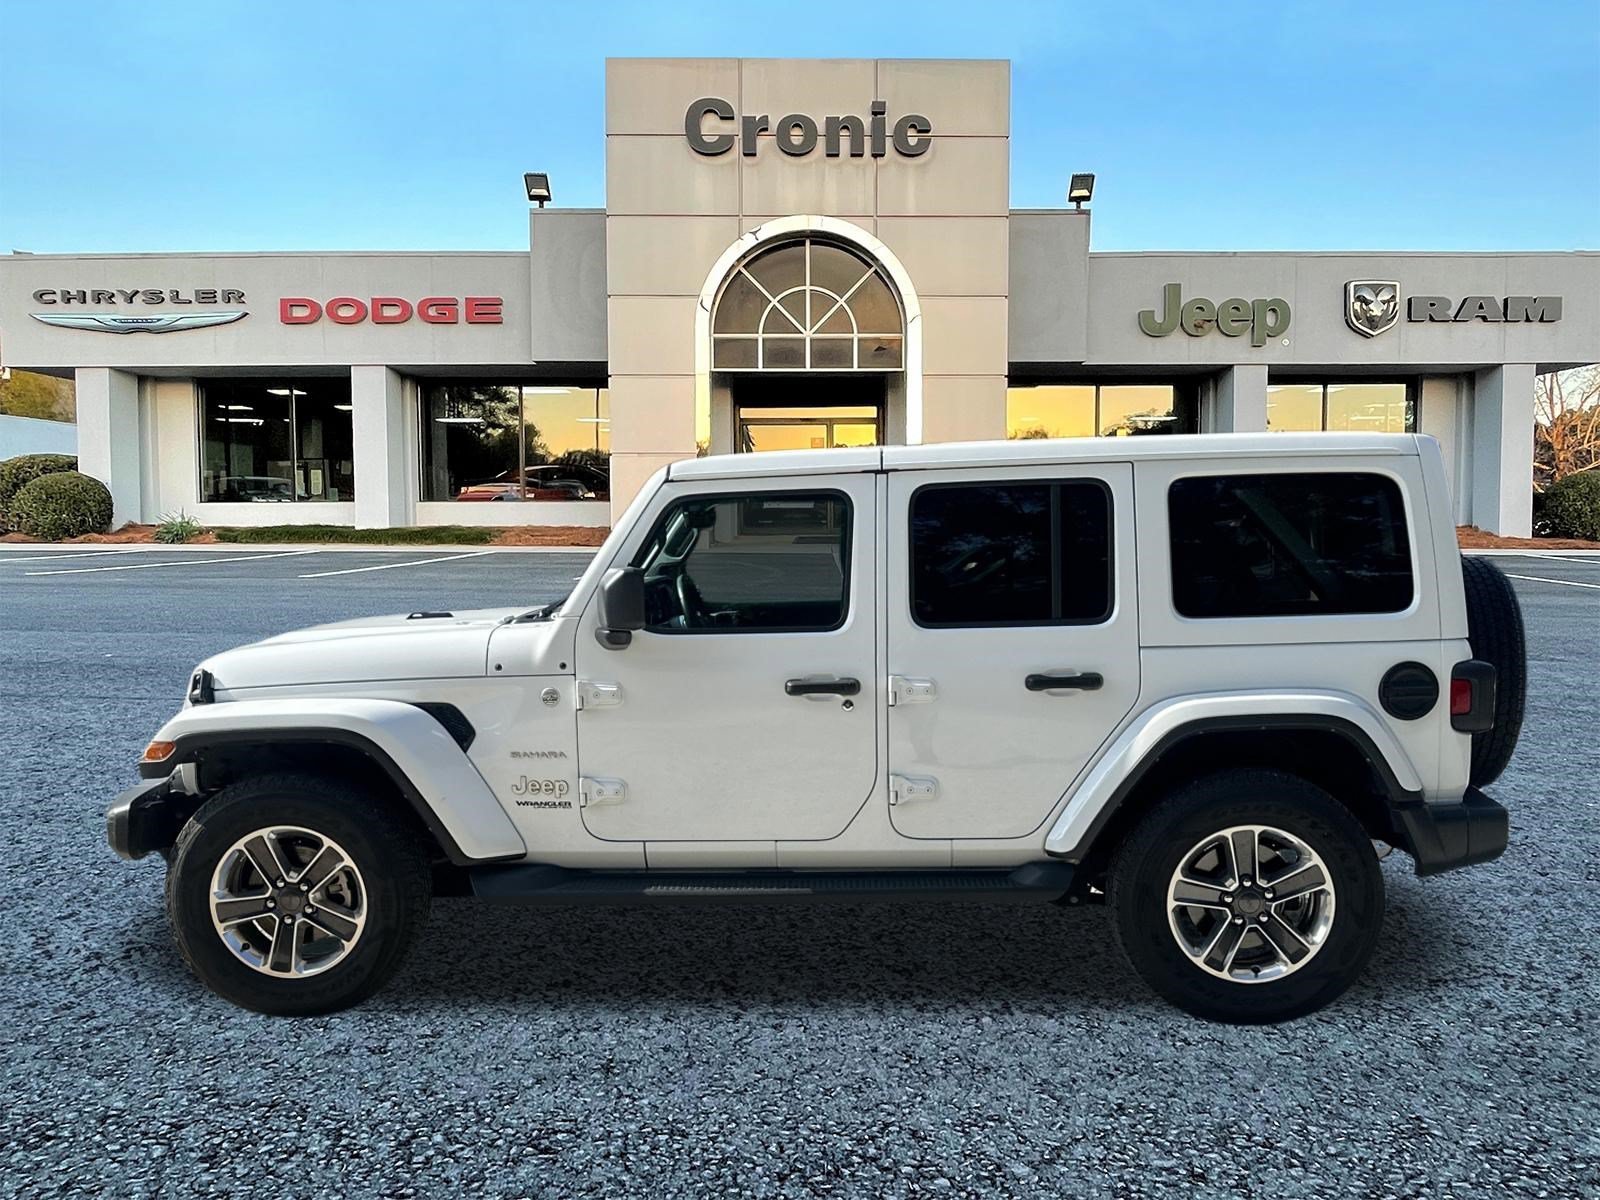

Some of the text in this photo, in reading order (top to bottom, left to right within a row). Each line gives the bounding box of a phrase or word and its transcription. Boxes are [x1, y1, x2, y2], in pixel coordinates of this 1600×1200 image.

[685, 97, 931, 157] Cronic
[32, 289, 247, 305] CHRYSLER
[1407, 296, 1563, 322] RAM
[280, 297, 503, 324] DODGE
[1138, 283, 1291, 347] Jeep
[511, 775, 569, 799] Jeep
